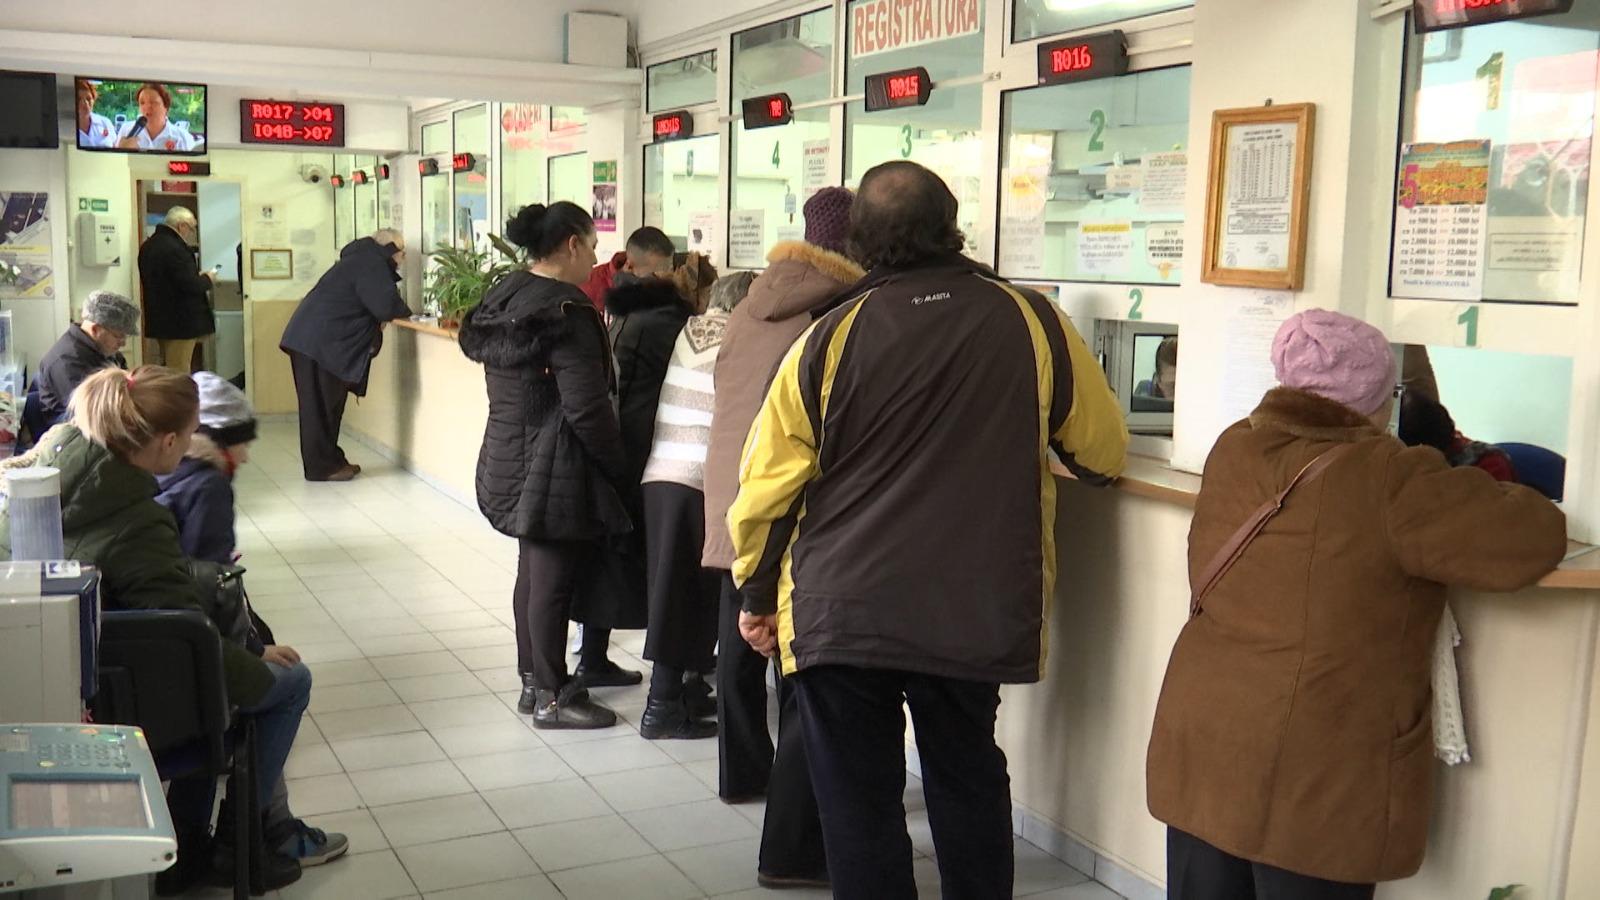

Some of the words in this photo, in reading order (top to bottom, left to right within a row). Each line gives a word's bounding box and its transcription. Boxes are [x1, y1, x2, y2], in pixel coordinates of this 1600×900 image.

[854, 0, 979, 56] REGISTRATURA
[1052, 45, 1091, 72] R016
[889, 75, 919, 98] R015
[1475, 51, 1504, 110] 1
[901, 124, 912, 158] 3
[1087, 110, 1105, 152] 2
[771, 140, 780, 169] 4
[1403, 164, 1419, 208] 5
[1128, 288, 1143, 320] 2
[1457, 306, 1479, 347] 1
